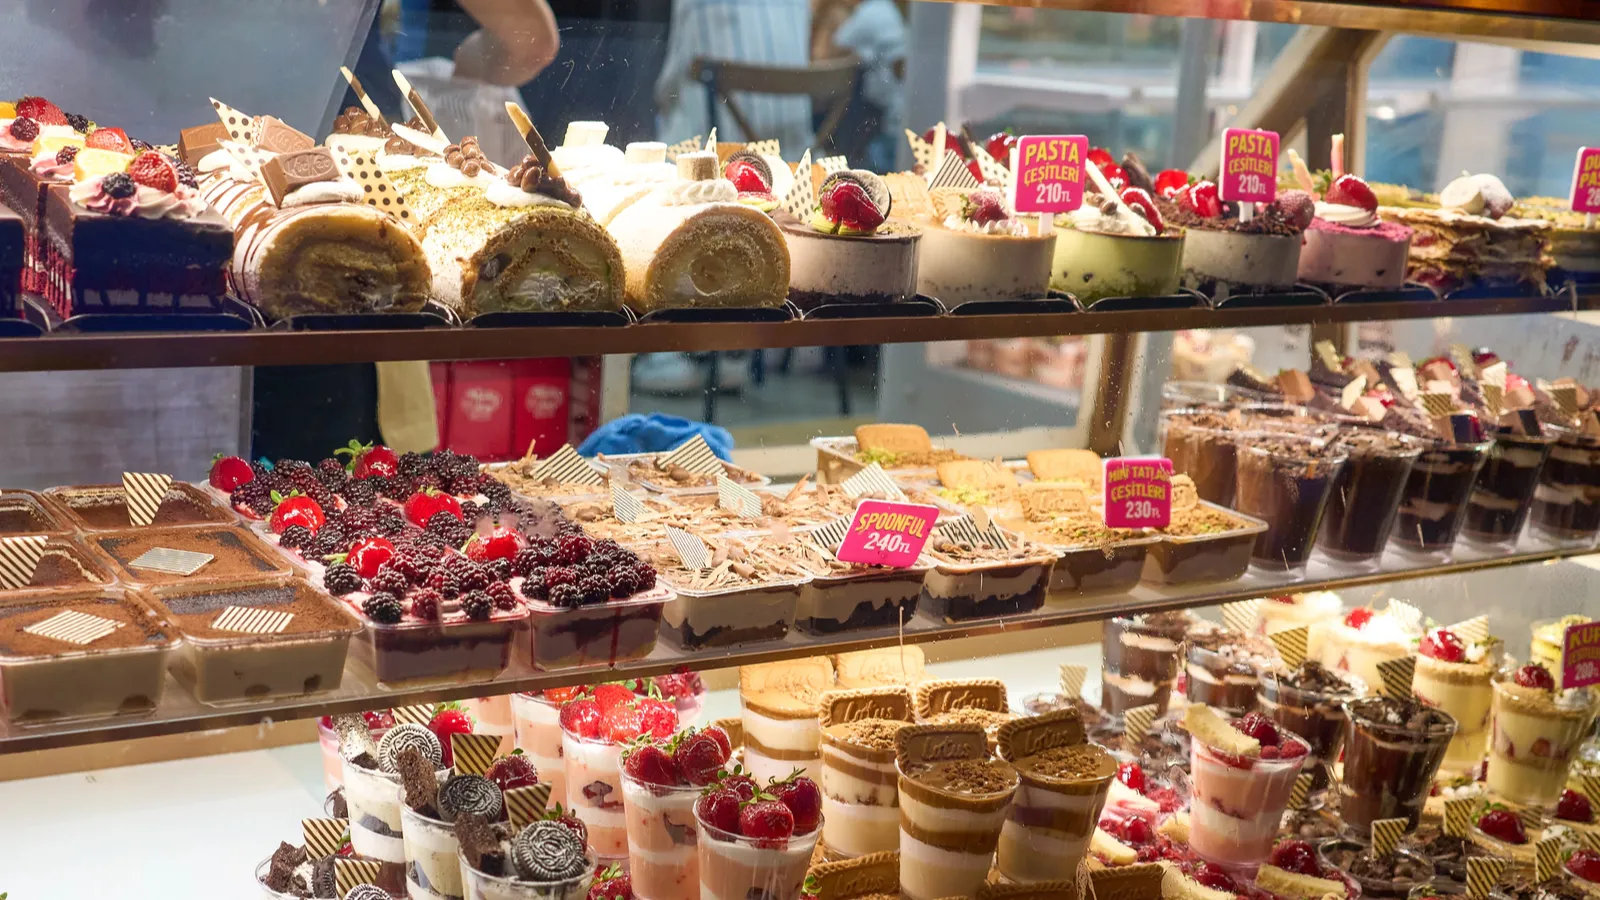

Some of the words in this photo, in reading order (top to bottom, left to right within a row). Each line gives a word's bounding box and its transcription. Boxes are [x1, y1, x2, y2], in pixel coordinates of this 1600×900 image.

[1025, 140, 1079, 166] PASTA
[1229, 134, 1272, 159] PASTA
[1024, 162, 1080, 187] ÇEŞİTLERİ
[1036, 183, 1071, 204] 210TL
[1111, 481, 1166, 503] ÇEŞİTLERİ
[855, 512, 926, 538] SPOONFUL
[863, 532, 910, 553] 240TL
[921, 735, 971, 760] Lotus
